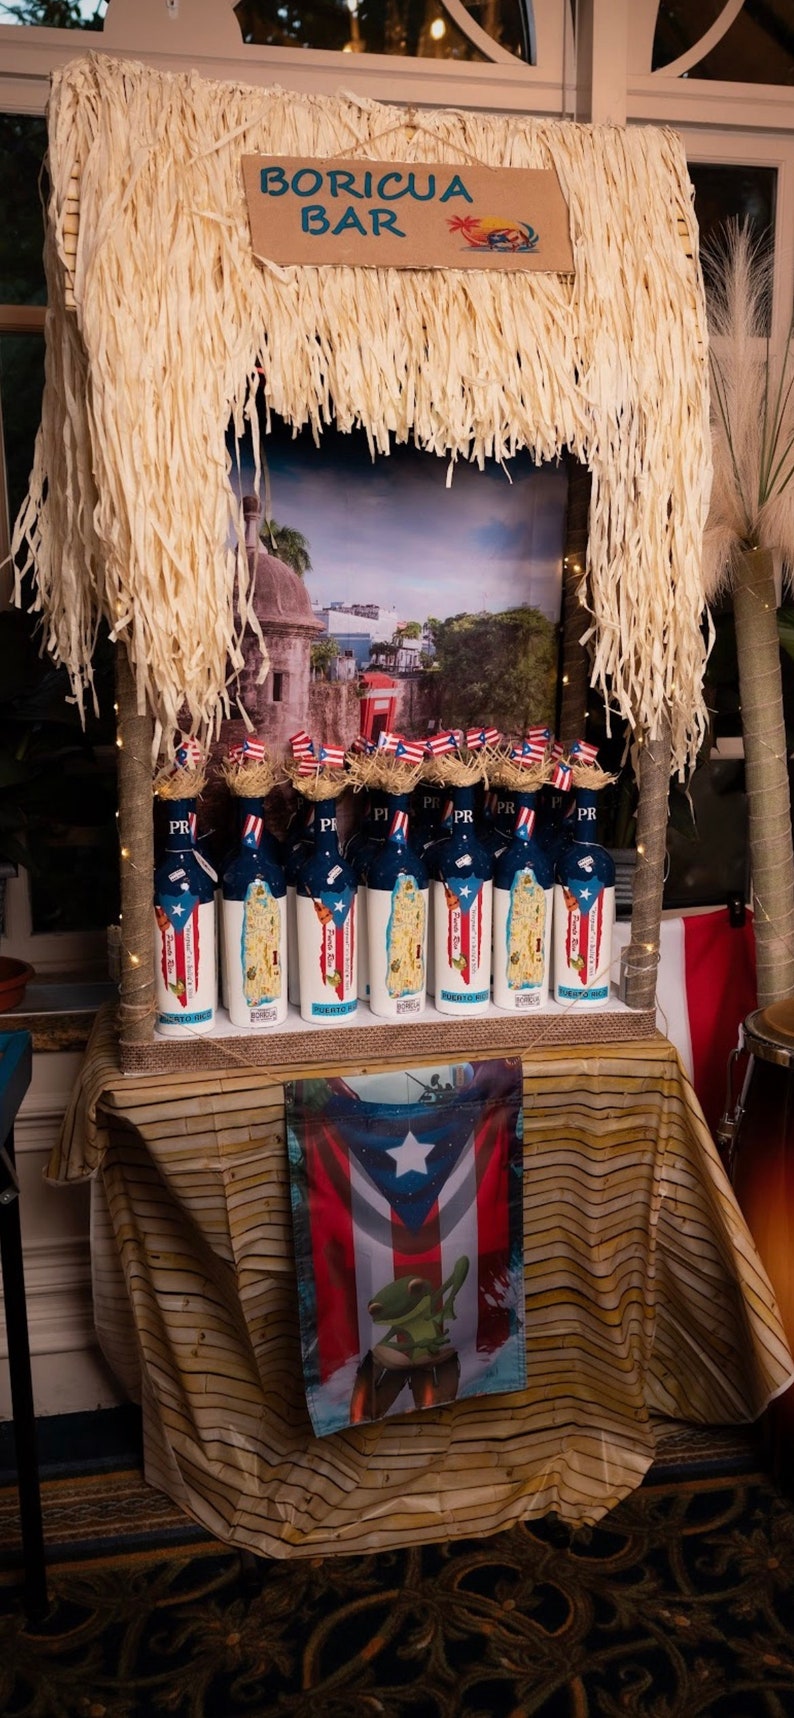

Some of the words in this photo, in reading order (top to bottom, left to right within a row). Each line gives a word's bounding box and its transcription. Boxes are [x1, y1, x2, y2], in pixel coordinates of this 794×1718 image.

[259, 166, 474, 204] BORICUA
[301, 204, 406, 238] BAR
[496, 802, 516, 815] PR
[577, 807, 598, 821] PR
[453, 810, 474, 824] PR
[169, 820, 190, 834] PR
[453, 911, 461, 934] Puerto
[572, 914, 580, 936] Puerto
[166, 934, 174, 957] Puerto
[327, 928, 335, 951] Puerto
[453, 935, 461, 950] Rico
[571, 937, 579, 952] Rico
[167, 958, 175, 975] Rico
[327, 953, 335, 968] Rico
[442, 992, 473, 1002] PUERTO
[194, 1010, 212, 1021] RICO
[314, 1005, 346, 1015] PUERTO
